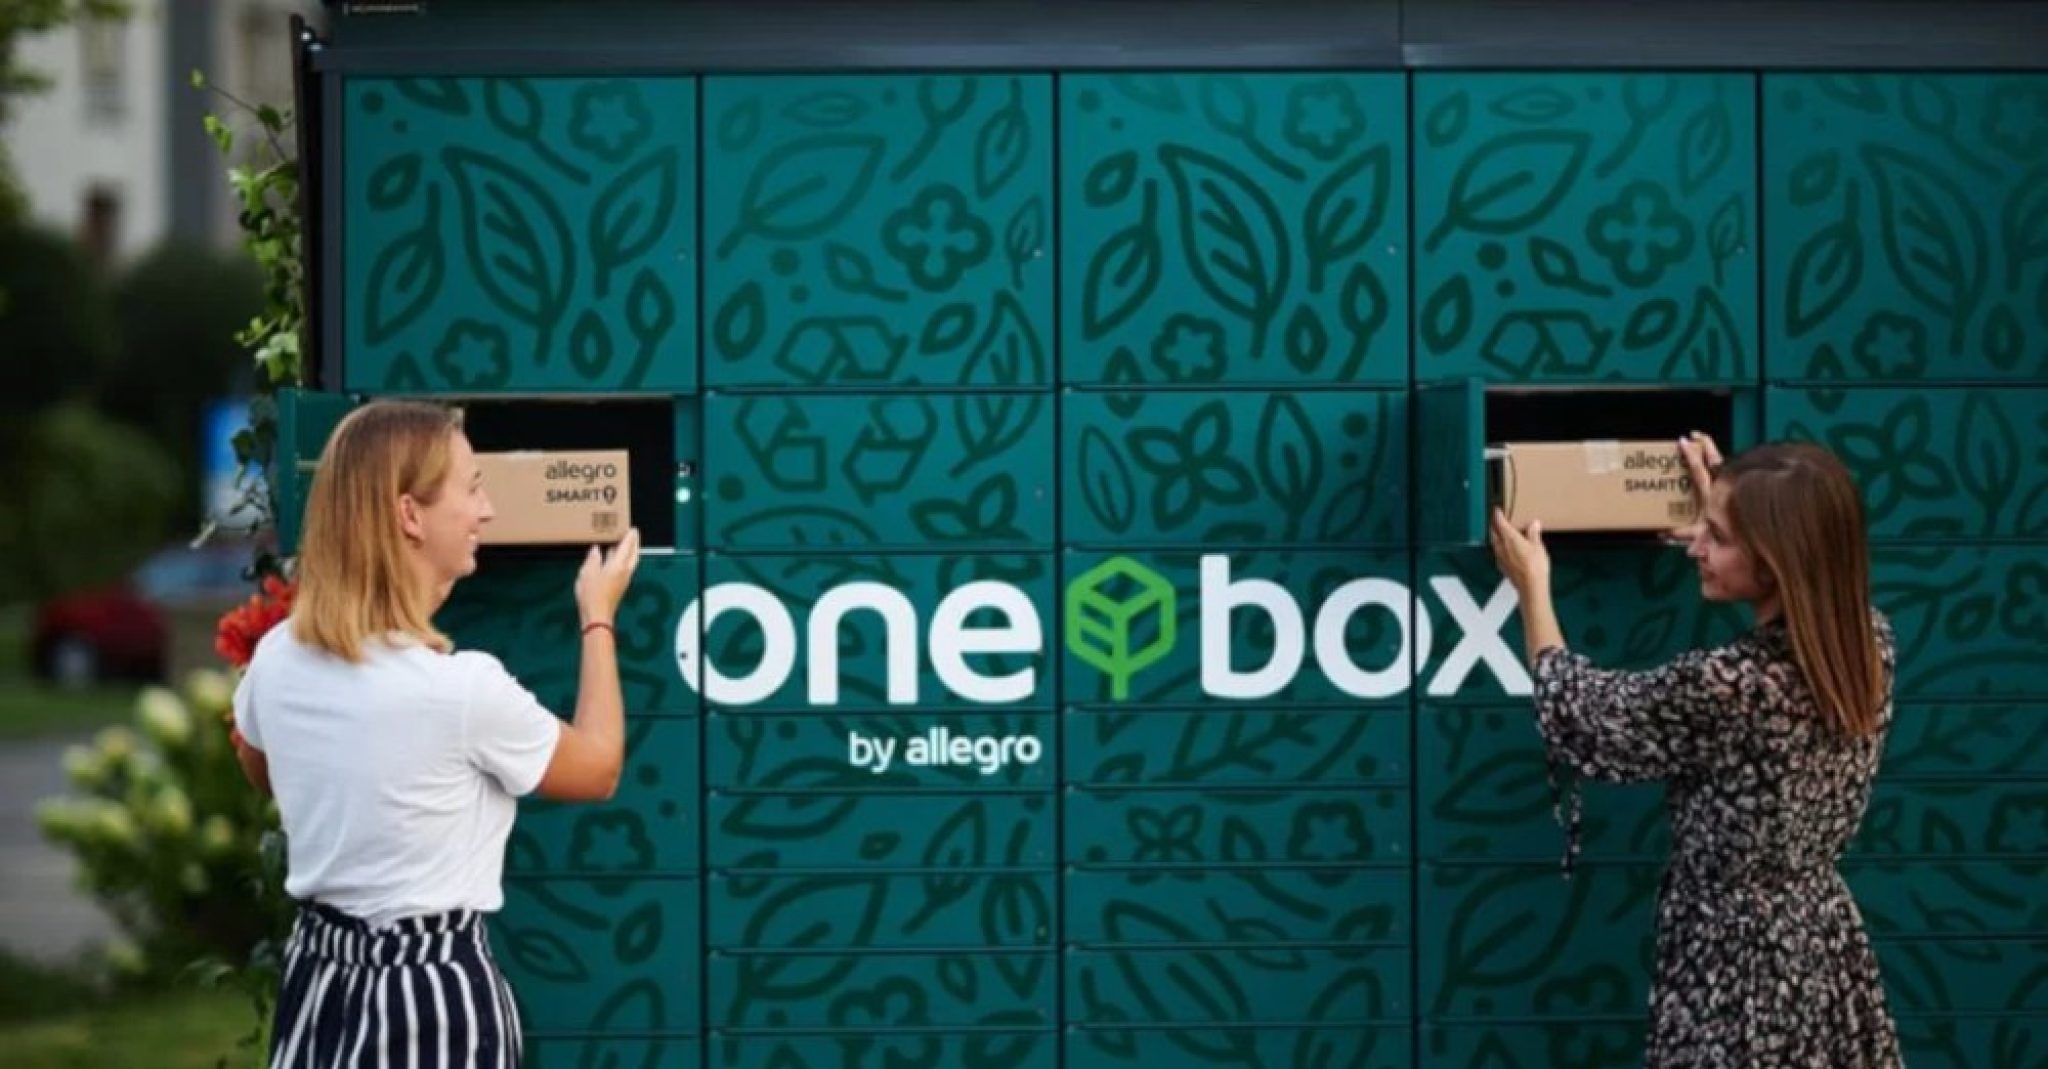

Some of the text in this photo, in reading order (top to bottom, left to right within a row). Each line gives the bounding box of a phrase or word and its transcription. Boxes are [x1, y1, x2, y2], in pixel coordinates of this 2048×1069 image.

[545, 460, 617, 484] allegro
[545, 487, 600, 504] SMART
[1625, 478, 1677, 492] SMART
[676, 554, 1535, 705] one box
[849, 726, 1042, 775] by allegro
